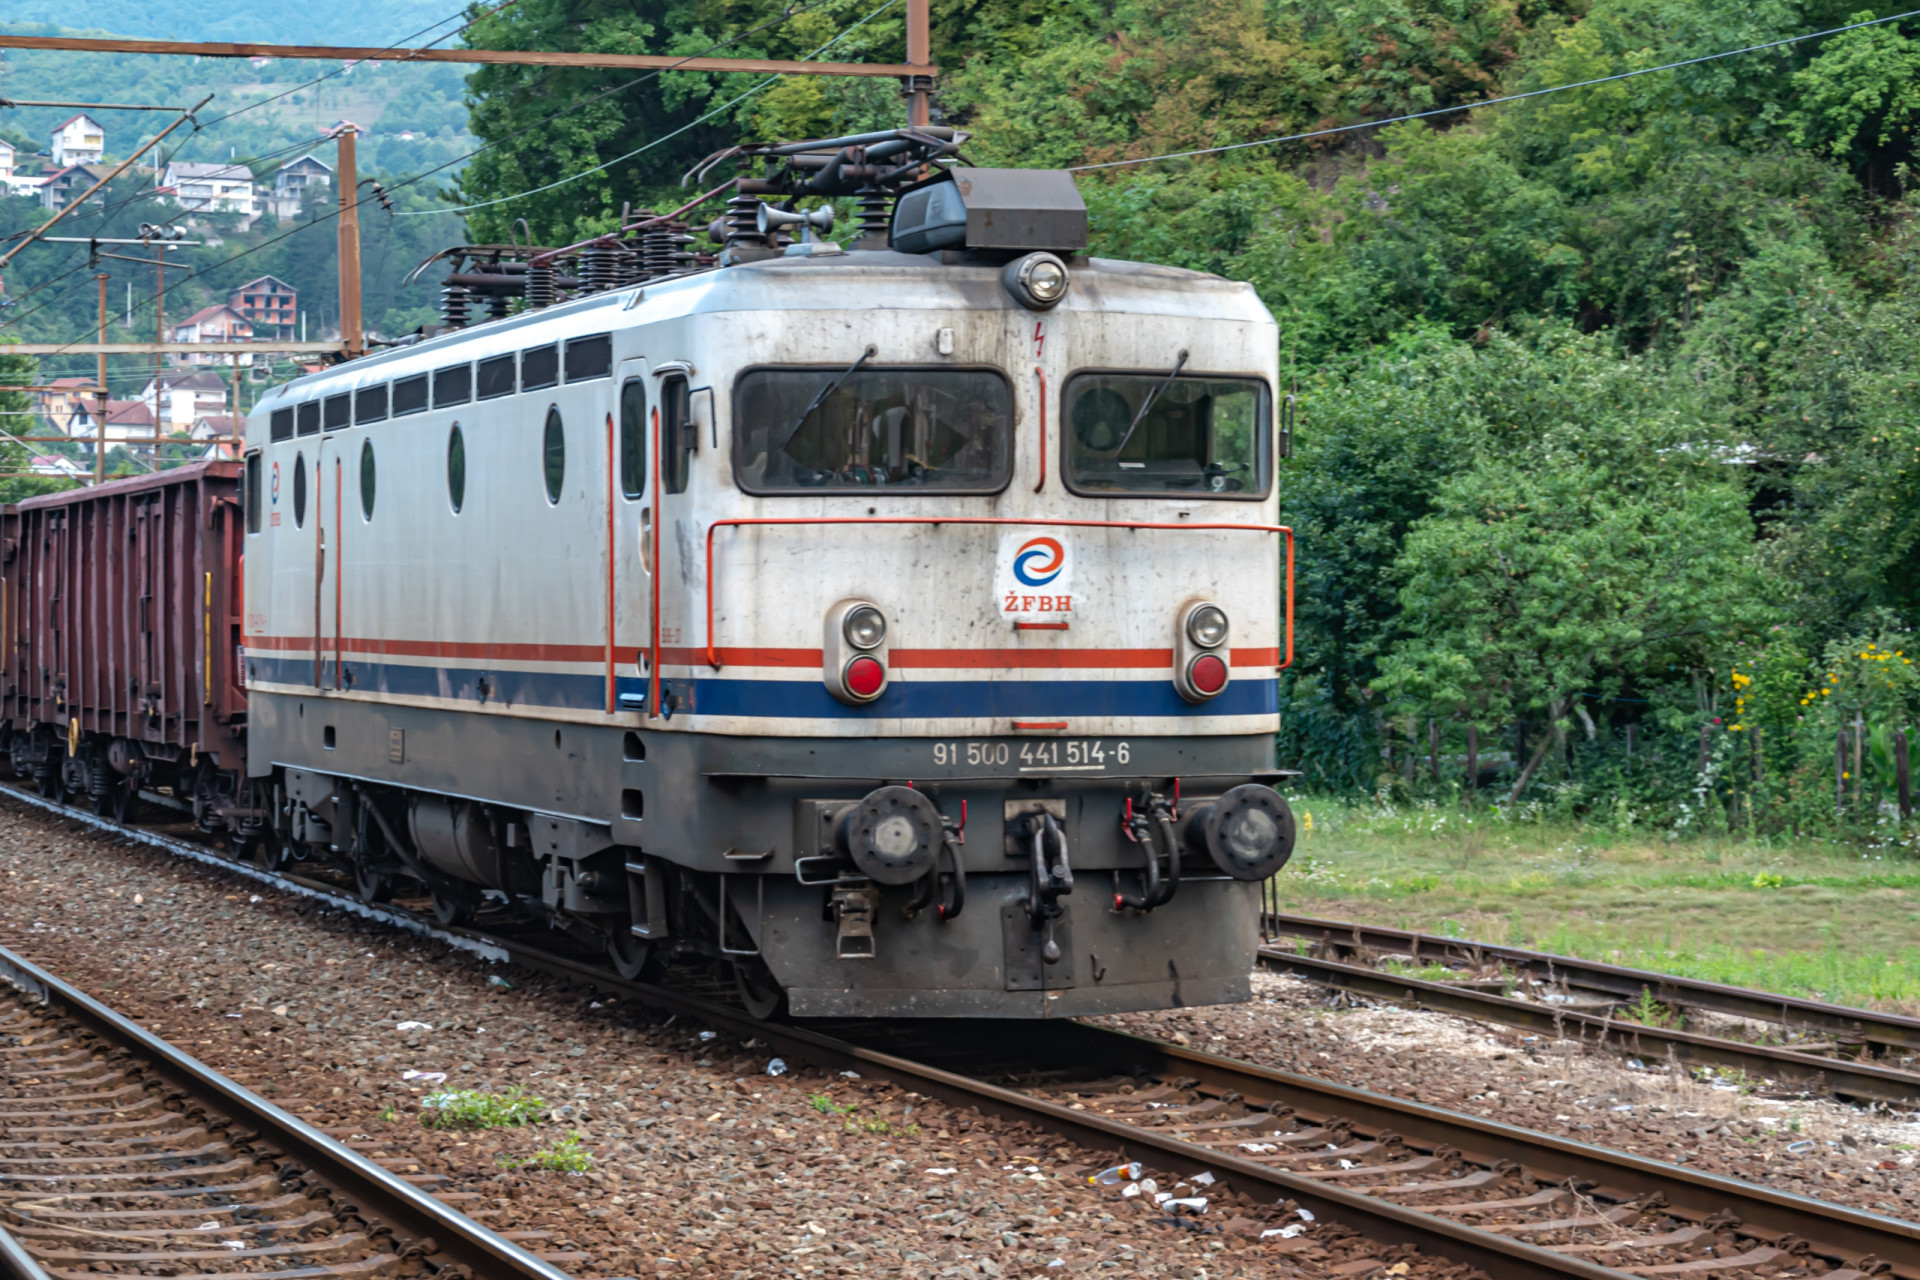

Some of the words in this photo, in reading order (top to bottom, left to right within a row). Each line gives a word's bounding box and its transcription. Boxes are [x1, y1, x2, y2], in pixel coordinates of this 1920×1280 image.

[1004, 590, 1072, 612] ŽFBH
[933, 742, 957, 765] 91
[967, 742, 1009, 765] 500
[1019, 742, 1058, 764] 441
[1066, 741, 1130, 764] 514-6
